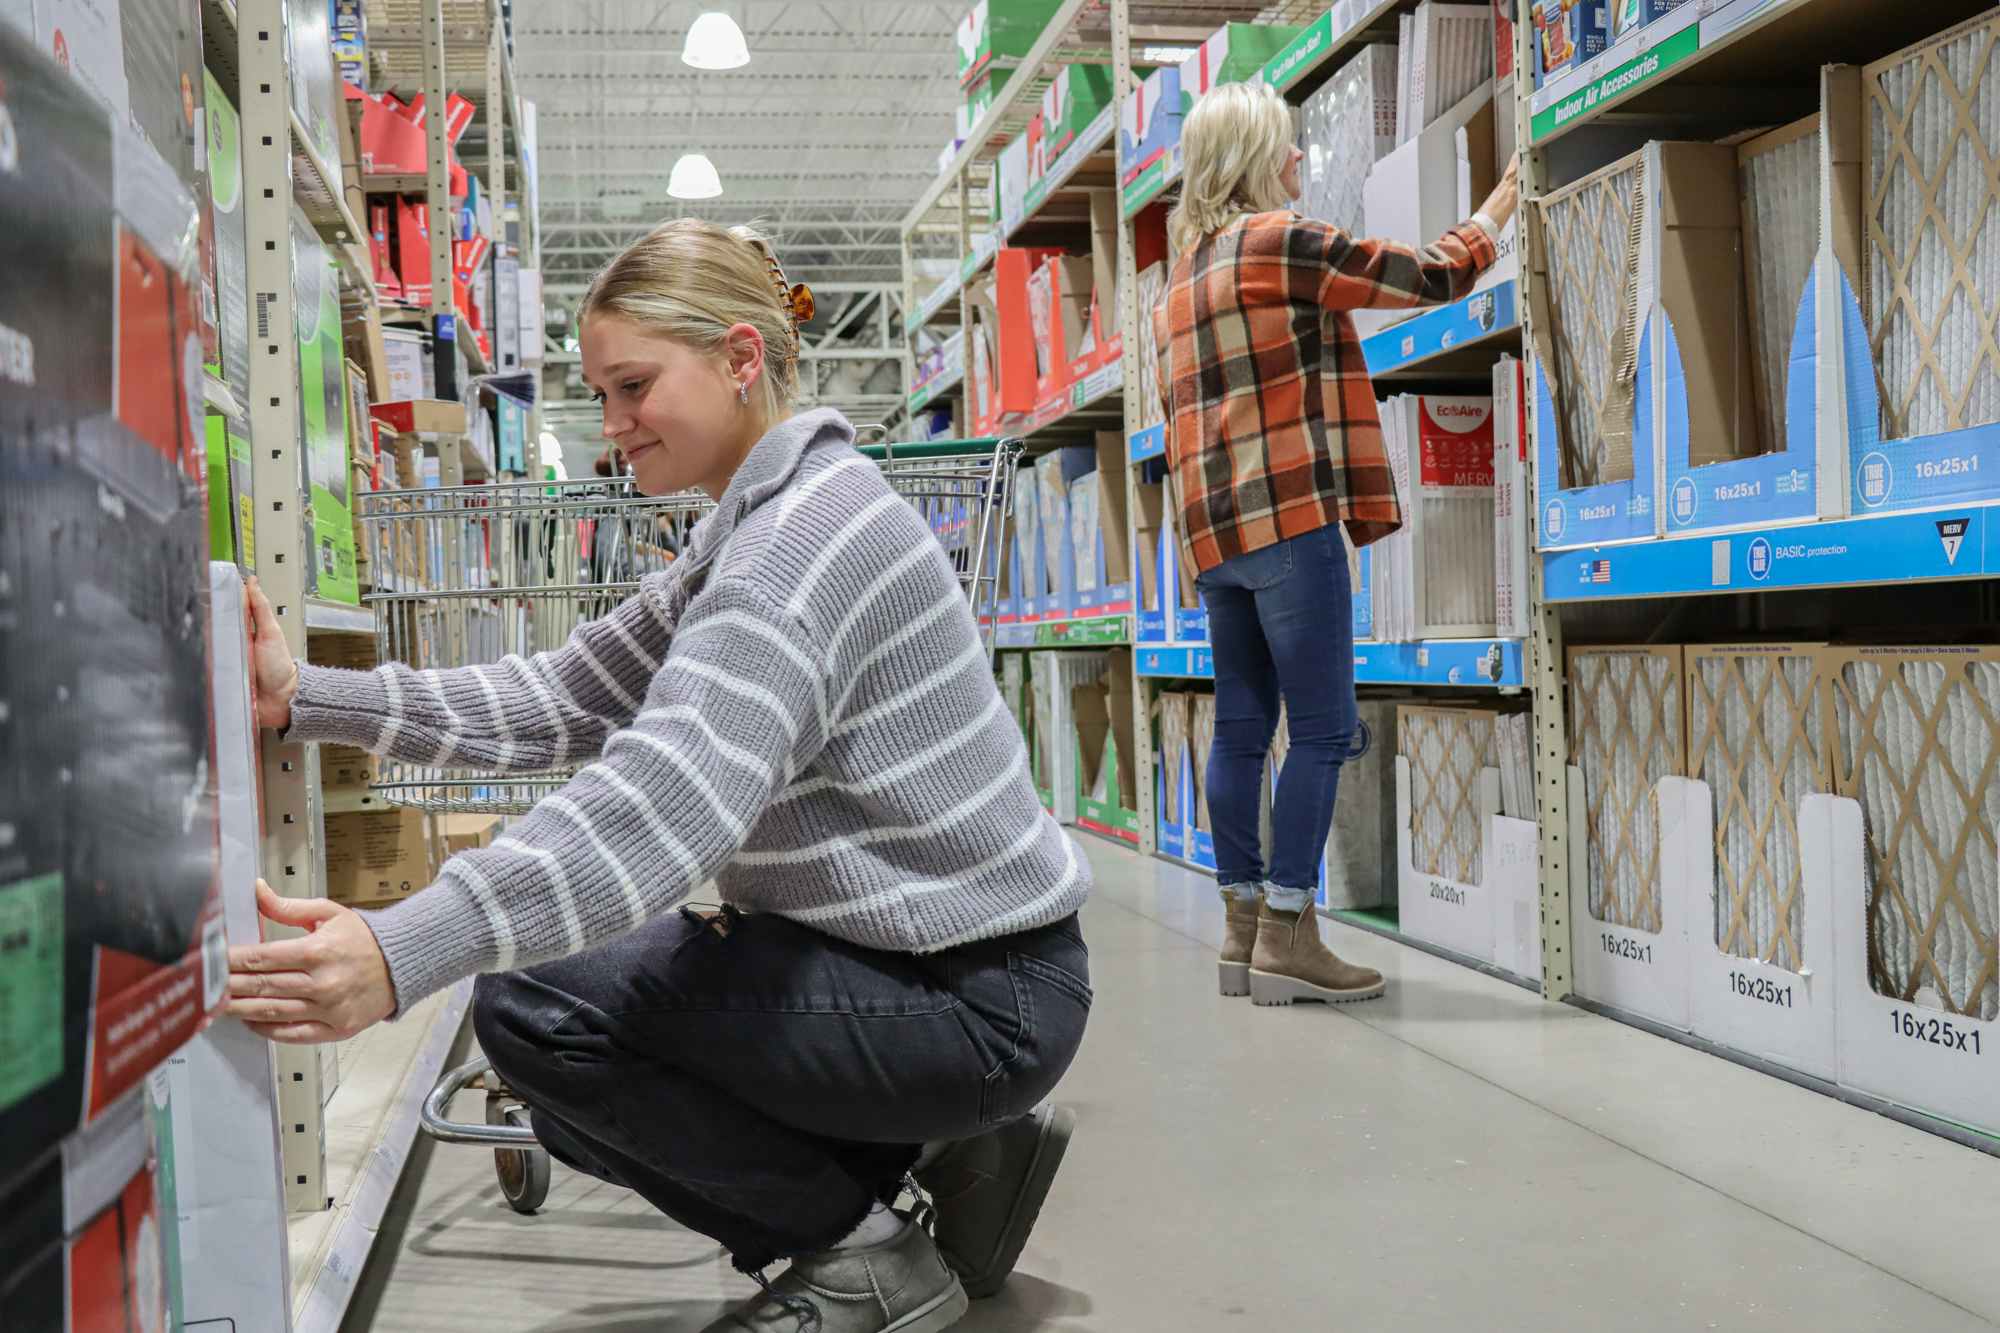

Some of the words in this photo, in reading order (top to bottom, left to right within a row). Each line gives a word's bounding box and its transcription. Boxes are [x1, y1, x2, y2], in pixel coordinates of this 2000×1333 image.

[1555, 98, 1584, 125] Indoor
[1584, 86, 1600, 108] Air
[1600, 54, 1659, 99] Accessories
[1864, 464, 1884, 480] TRUE
[1915, 455, 1979, 478] 16x25x1
[1715, 481, 1760, 501] 16x25x1
[1865, 480, 1885, 496] BLUE
[1579, 504, 1616, 520] 16x25x1
[1943, 524, 1962, 535] MERV
[1776, 545, 1805, 559] BASIC
[1807, 546, 1847, 558] protection
[1949, 541, 1955, 555] 7
[1430, 881, 1465, 907] 20x20x1
[1601, 933, 1652, 964] 16x25x1
[1729, 971, 1792, 1008] 16x25x1
[1891, 1009, 1980, 1055] 16x25x1
